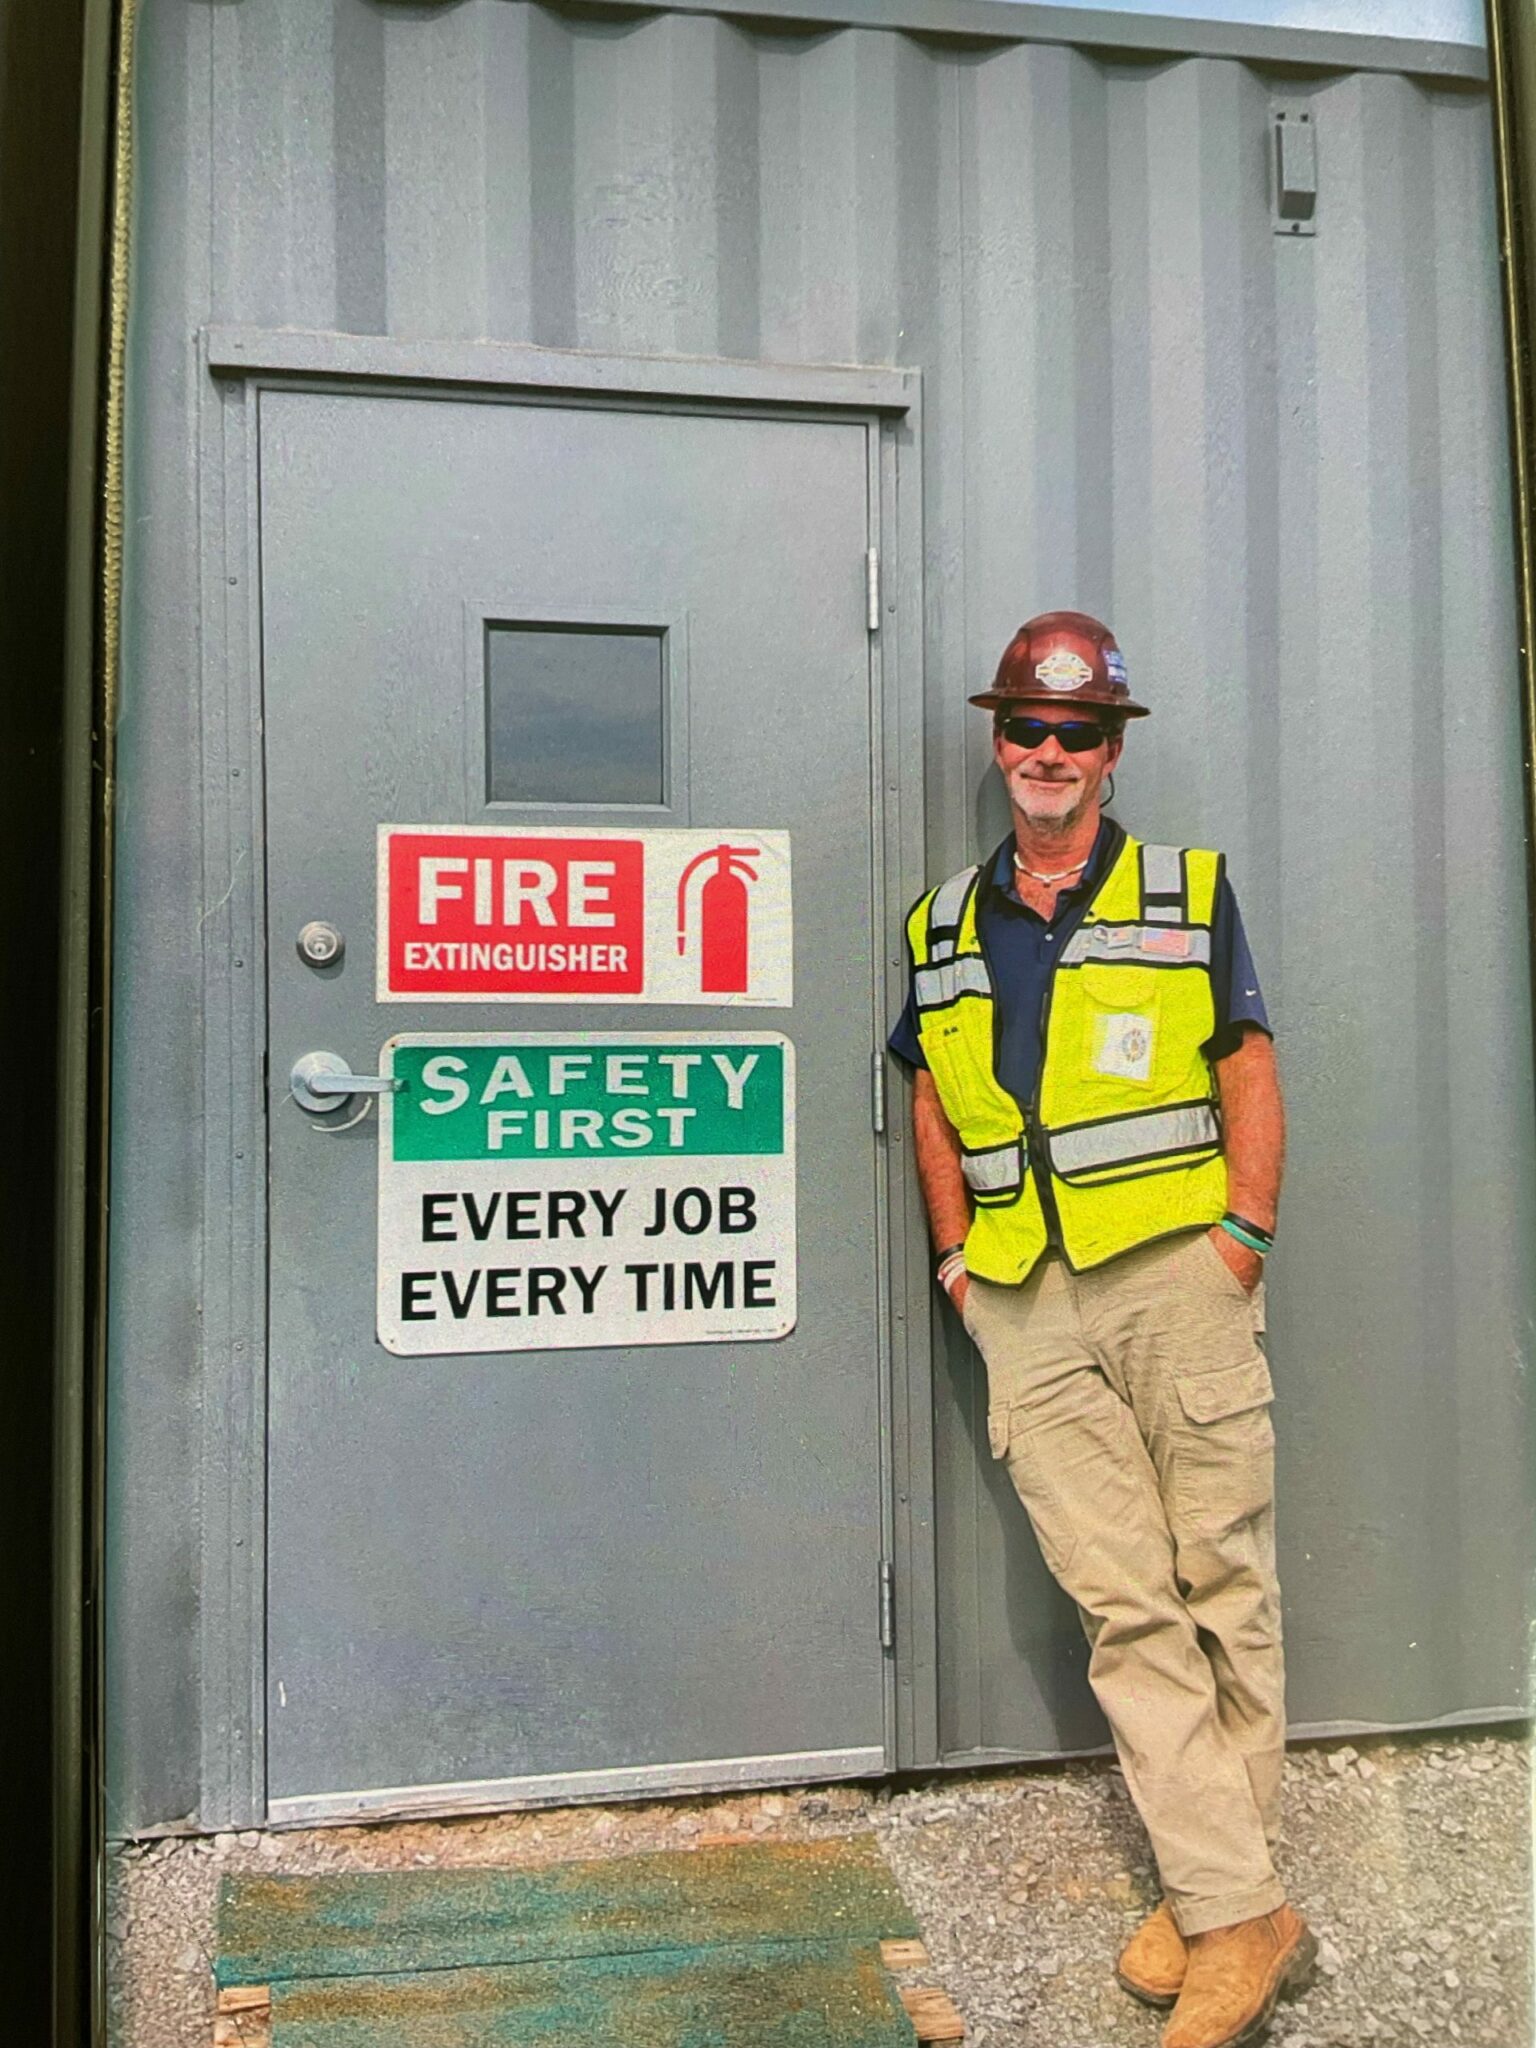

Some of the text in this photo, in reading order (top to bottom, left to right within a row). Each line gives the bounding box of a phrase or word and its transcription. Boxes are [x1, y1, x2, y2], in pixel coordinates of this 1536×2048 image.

[418, 856, 616, 928] FIRE
[404, 941, 629, 973] EXTINGUISHER
[419, 1053, 760, 1116] SAFETY
[487, 1107, 697, 1151] FIRST
[421, 1186, 758, 1243] EVERY JOB
[401, 1260, 777, 1321] EVERY TIME
